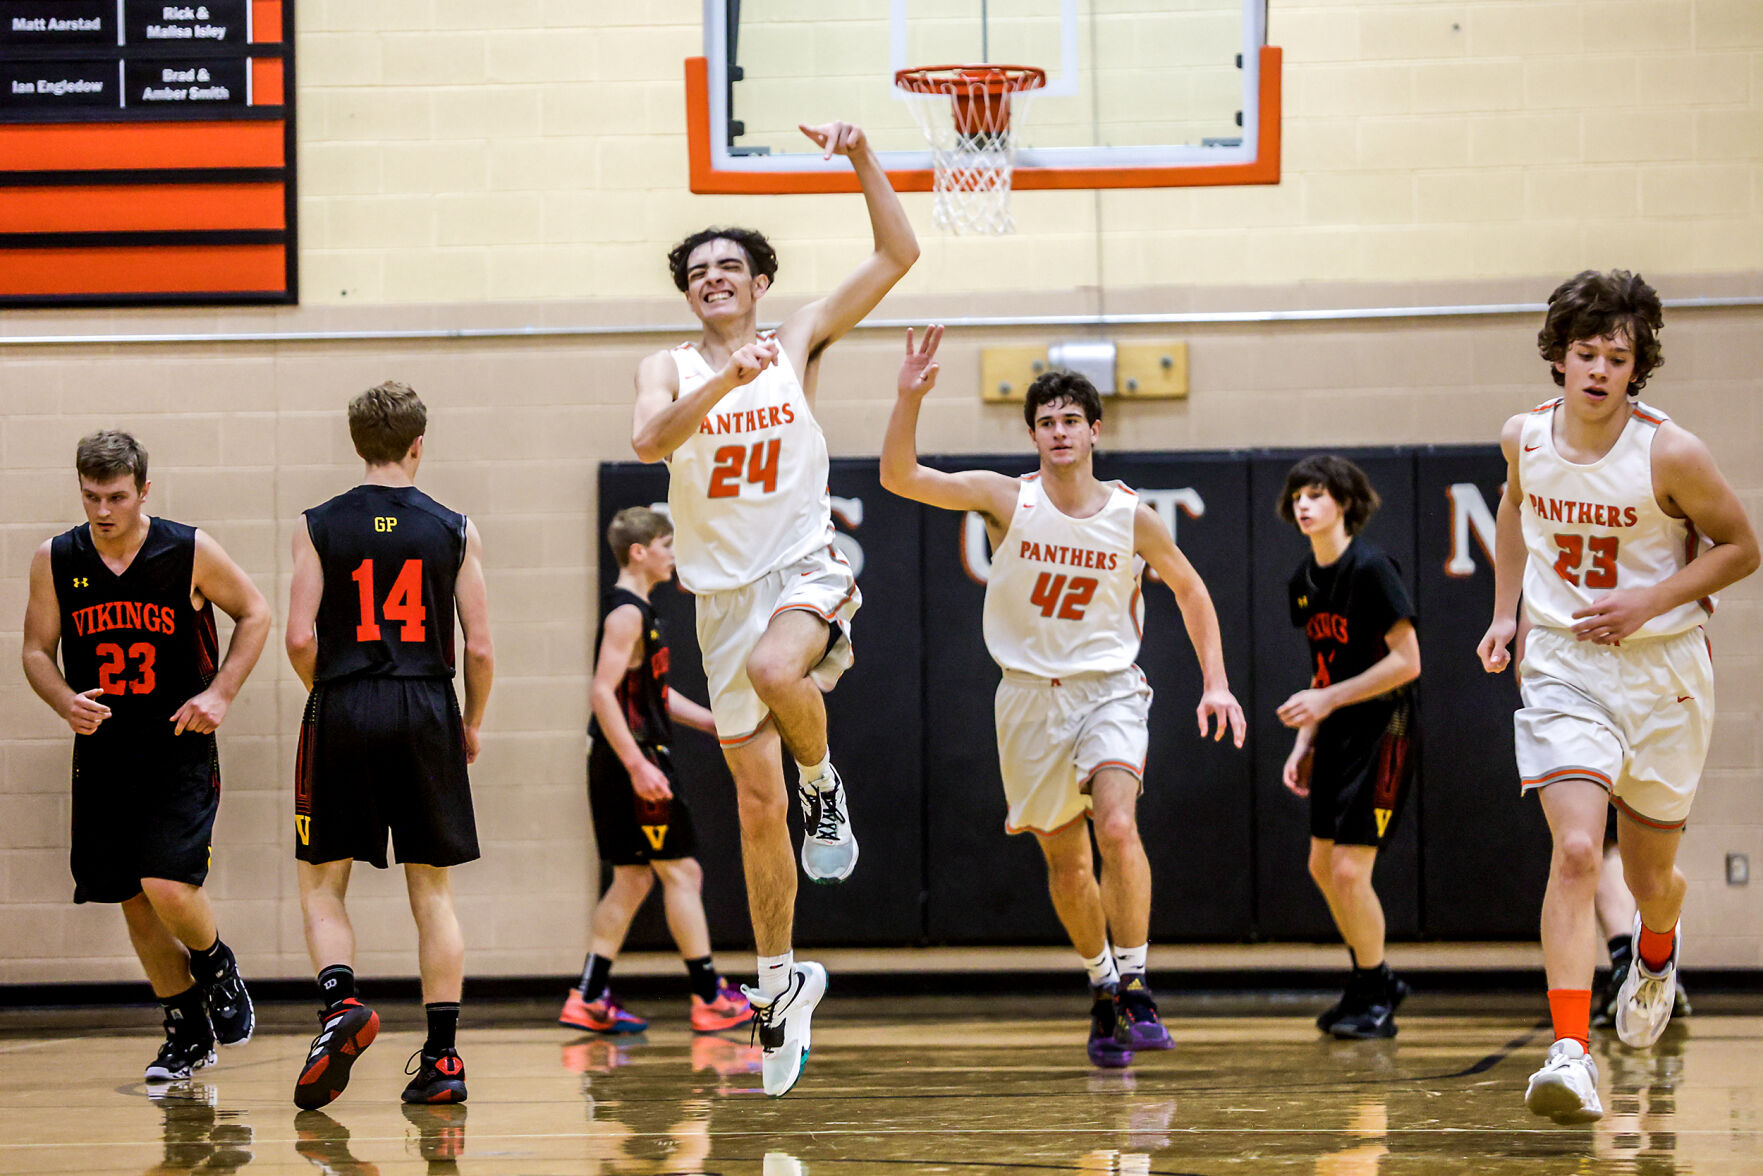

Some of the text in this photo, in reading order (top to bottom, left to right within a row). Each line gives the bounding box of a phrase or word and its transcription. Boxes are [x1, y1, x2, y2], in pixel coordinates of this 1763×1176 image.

[12, 17, 101, 31] Matt Aarstad
[163, 6, 210, 20] Rick &
[12, 80, 35, 94] Ian
[162, 68, 210, 82] Brad &
[142, 86, 230, 100] Amber Smith
[699, 402, 795, 436] ANTHERS
[707, 437, 782, 499] 24
[374, 516, 398, 533] GP
[1529, 493, 1638, 528] PANTHERS
[1019, 540, 1118, 571] PANTHERS
[1552, 533, 1620, 590] 23
[351, 558, 427, 643] 14
[1030, 571, 1099, 621] 42
[72, 601, 176, 637] VIKINGS
[96, 642, 156, 696] 23
[641, 824, 670, 851] V
